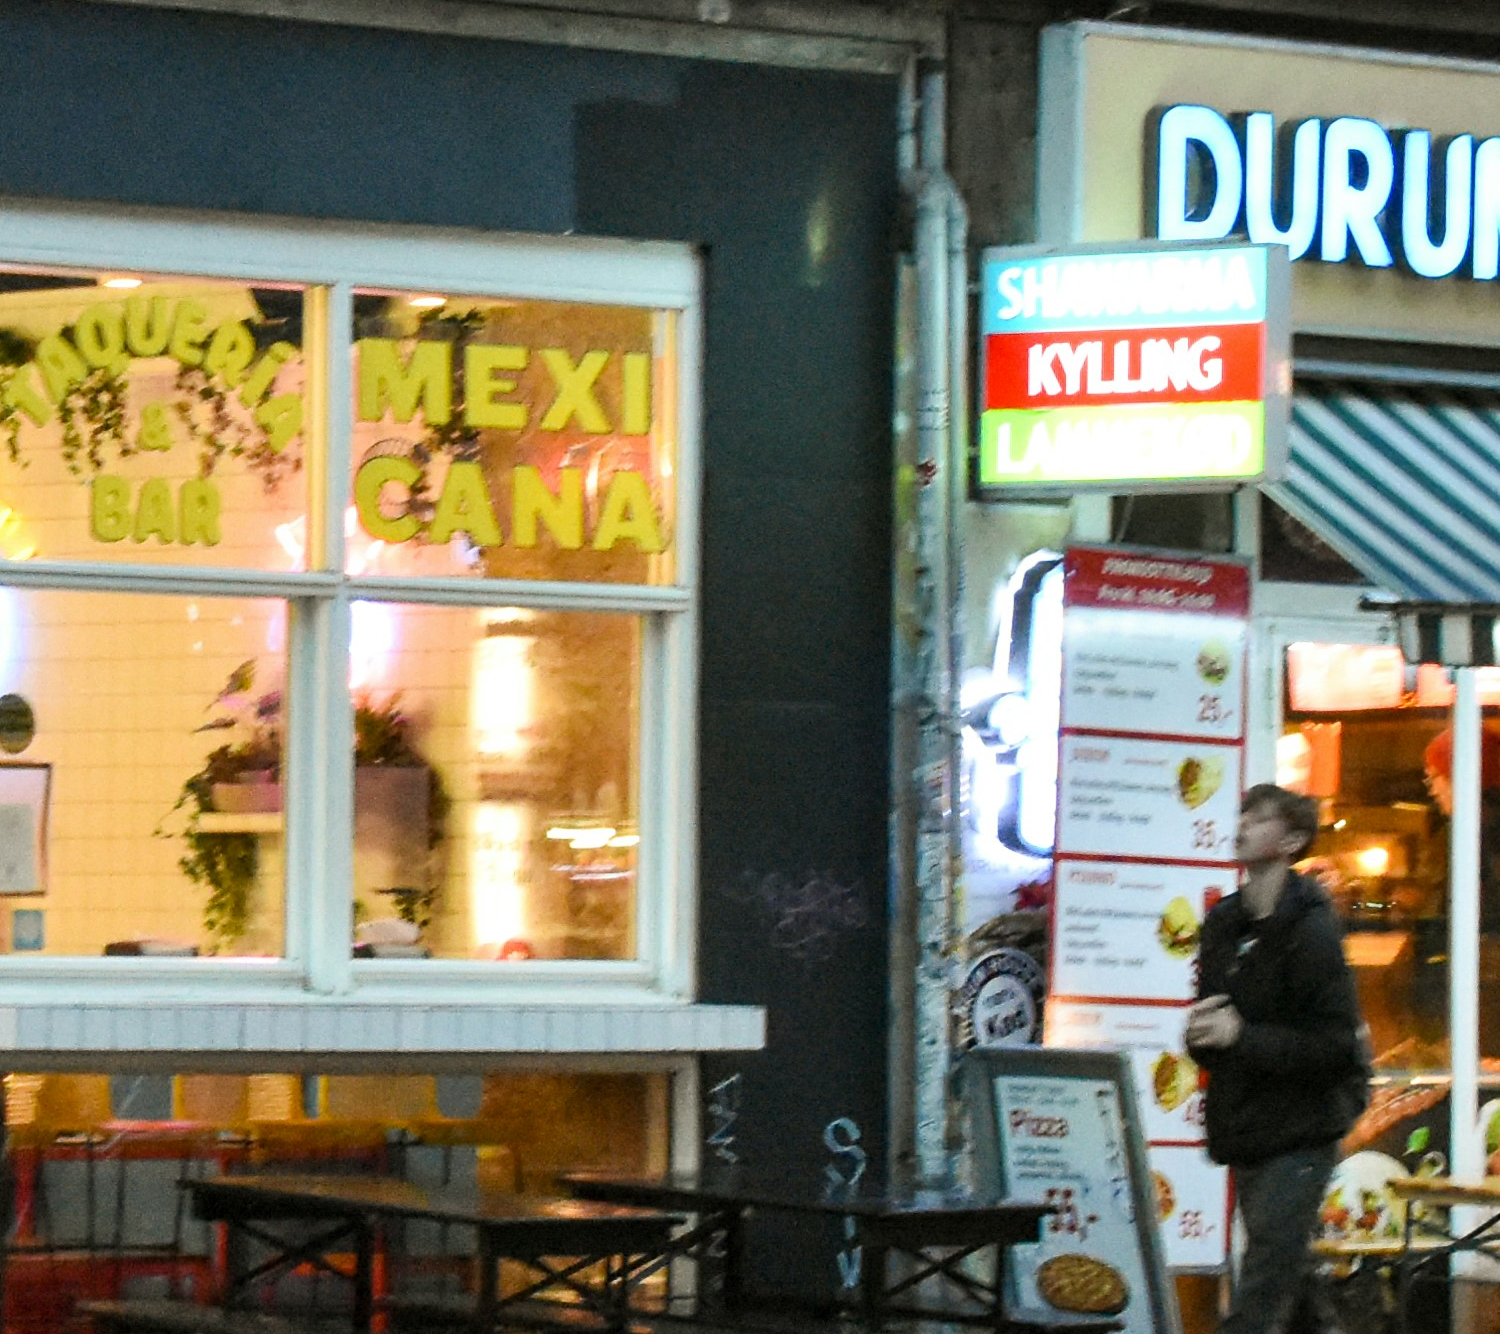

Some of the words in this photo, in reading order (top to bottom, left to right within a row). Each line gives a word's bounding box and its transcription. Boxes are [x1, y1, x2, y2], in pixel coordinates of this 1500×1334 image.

[354, 336, 651, 435] MEXI
[1027, 334, 1223, 398] KYLLING
[137, 400, 175, 452] &
[90, 473, 222, 546] BAR
[354, 455, 668, 554] CANA
